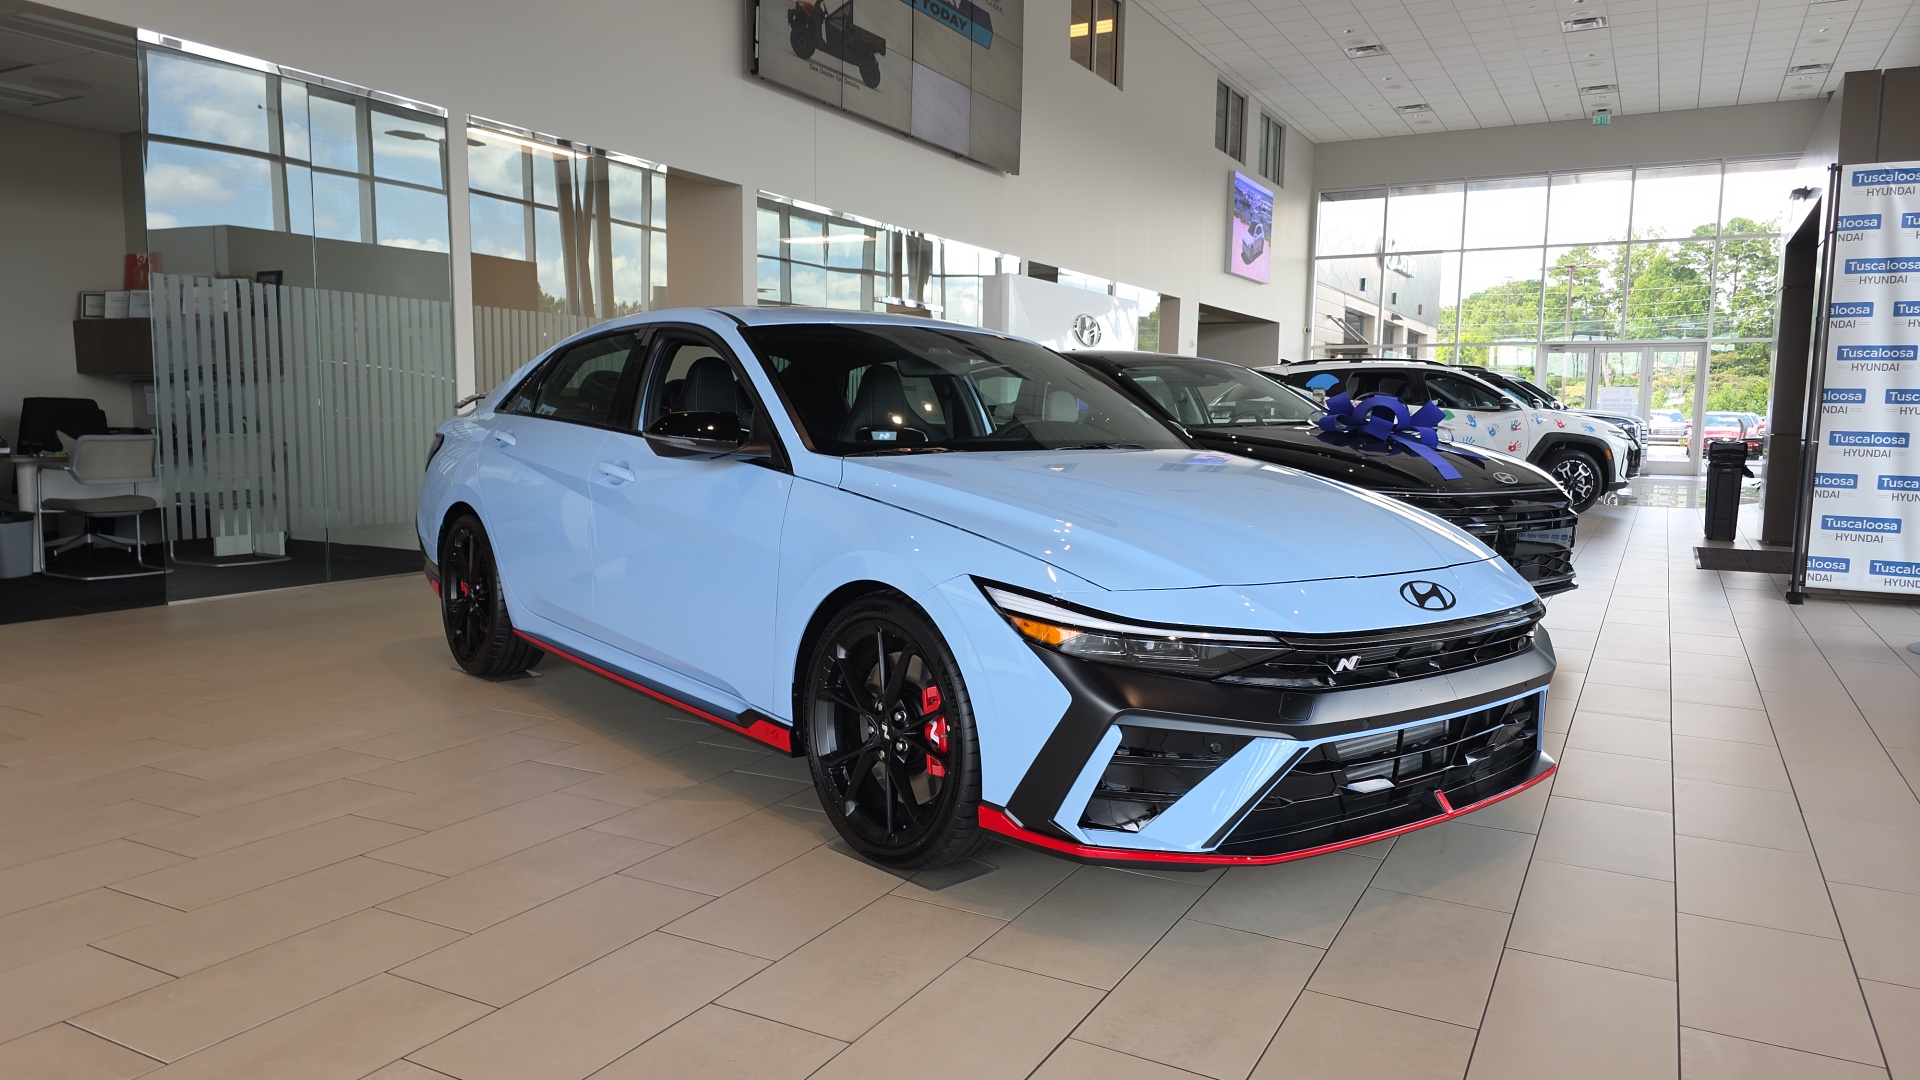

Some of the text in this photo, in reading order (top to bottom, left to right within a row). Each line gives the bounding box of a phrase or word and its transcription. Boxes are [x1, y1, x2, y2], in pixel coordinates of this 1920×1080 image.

[923, 0, 968, 30] TODAY
[809, 63, 819, 73] See
[820, 67, 835, 80] Dealer
[1866, 186, 1916, 197] HYUNDAI
[1838, 232, 1864, 242] NDAI
[1849, 260, 1920, 271] Tuscaloosa
[1859, 275, 1908, 285] HYUNDAI
[1830, 320, 1856, 329] NDAI
[1841, 348, 1914, 358] Tuscaloosa
[1851, 363, 1900, 372] HYUNDAI
[1822, 405, 1848, 414] NDAI
[1833, 433, 1906, 445] Tuscaloosa
[1843, 448, 1892, 458] HYUNDAI
[1814, 489, 1840, 499] NDAI
[1825, 517, 1898, 531] Tuscaloosa
[1835, 532, 1884, 544] HYUNDAI
[1807, 573, 1833, 582] NDAI
[1336, 655, 1361, 671] N
